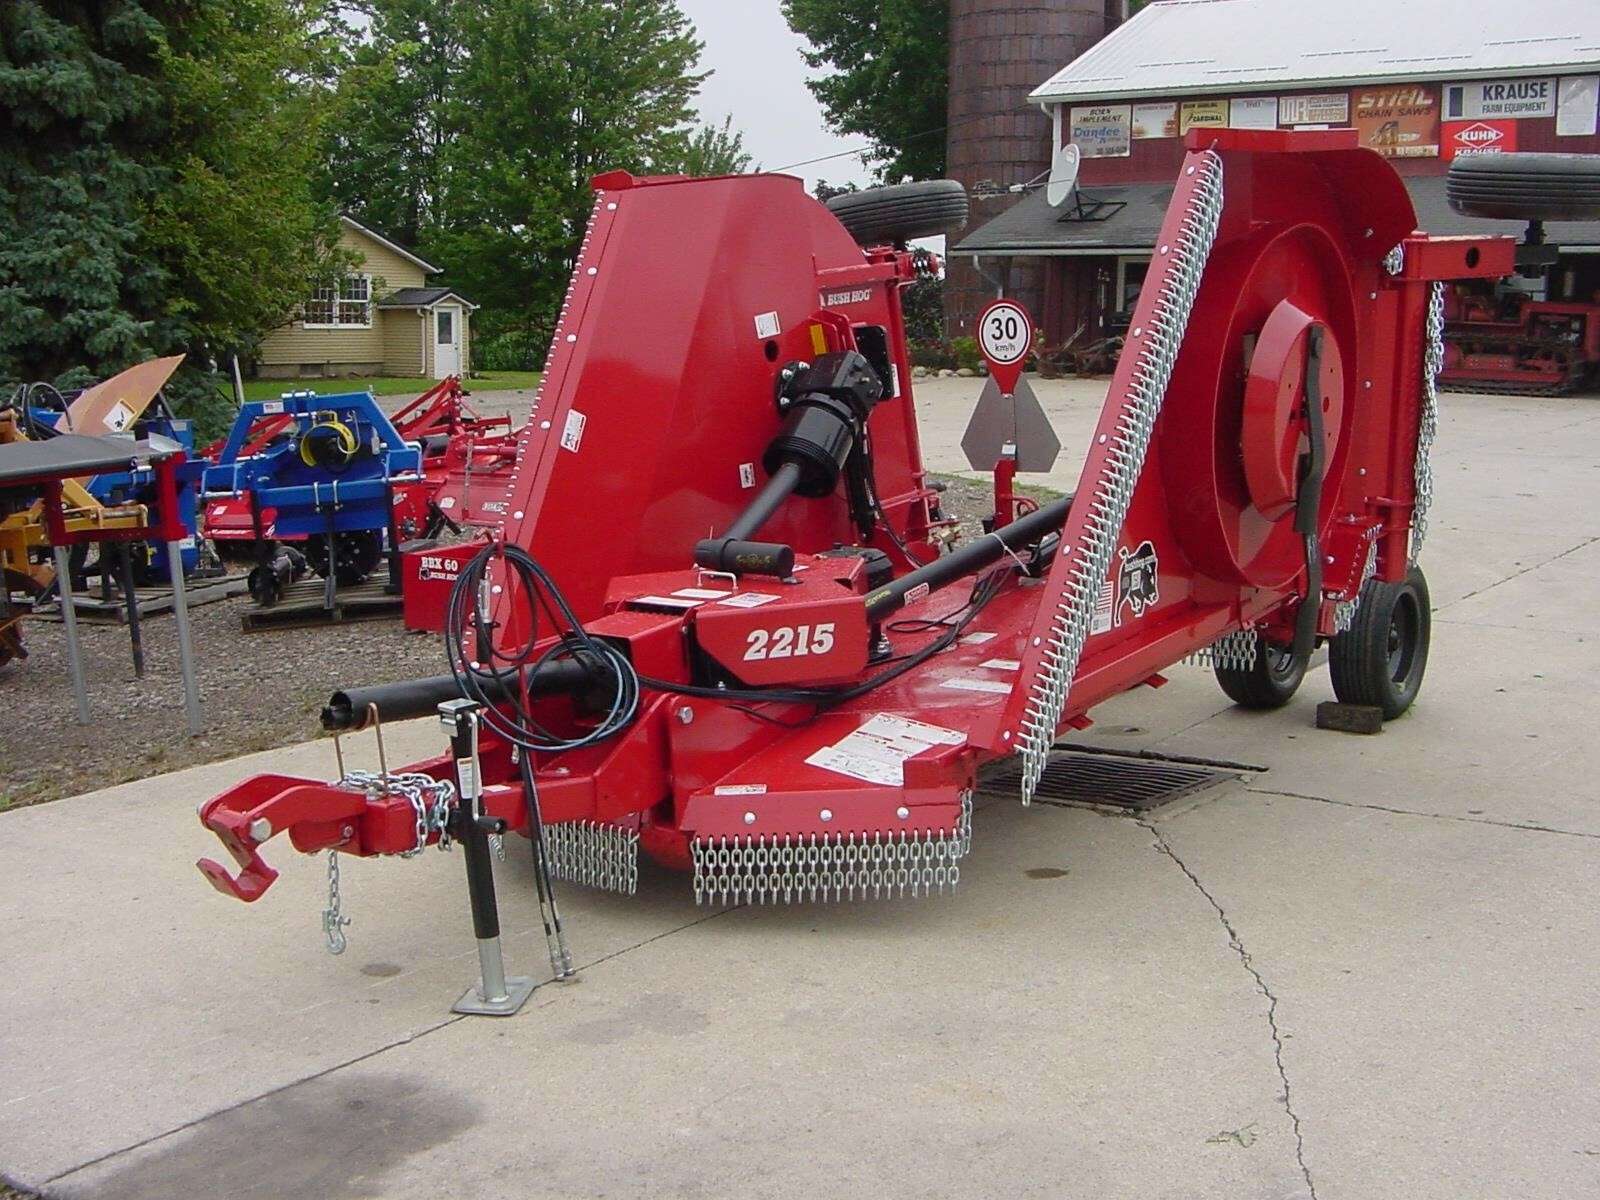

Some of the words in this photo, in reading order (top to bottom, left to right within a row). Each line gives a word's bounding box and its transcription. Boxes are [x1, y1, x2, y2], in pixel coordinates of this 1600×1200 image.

[1358, 89, 1433, 108] STIHL
[1483, 83, 1548, 101] KRAUSE
[1357, 109, 1392, 118] CHAIN
[1398, 108, 1431, 116] SAWS
[1482, 104, 1503, 114] FARM
[1504, 102, 1547, 114] EQUIPMENT
[1462, 131, 1497, 141] KUHN
[827, 292, 850, 306] BUSH
[851, 289, 870, 303] HOG
[991, 317, 1017, 340] 30
[994, 343, 1016, 351] km/h
[444, 559, 458, 571] 60
[743, 623, 835, 661] 2215
